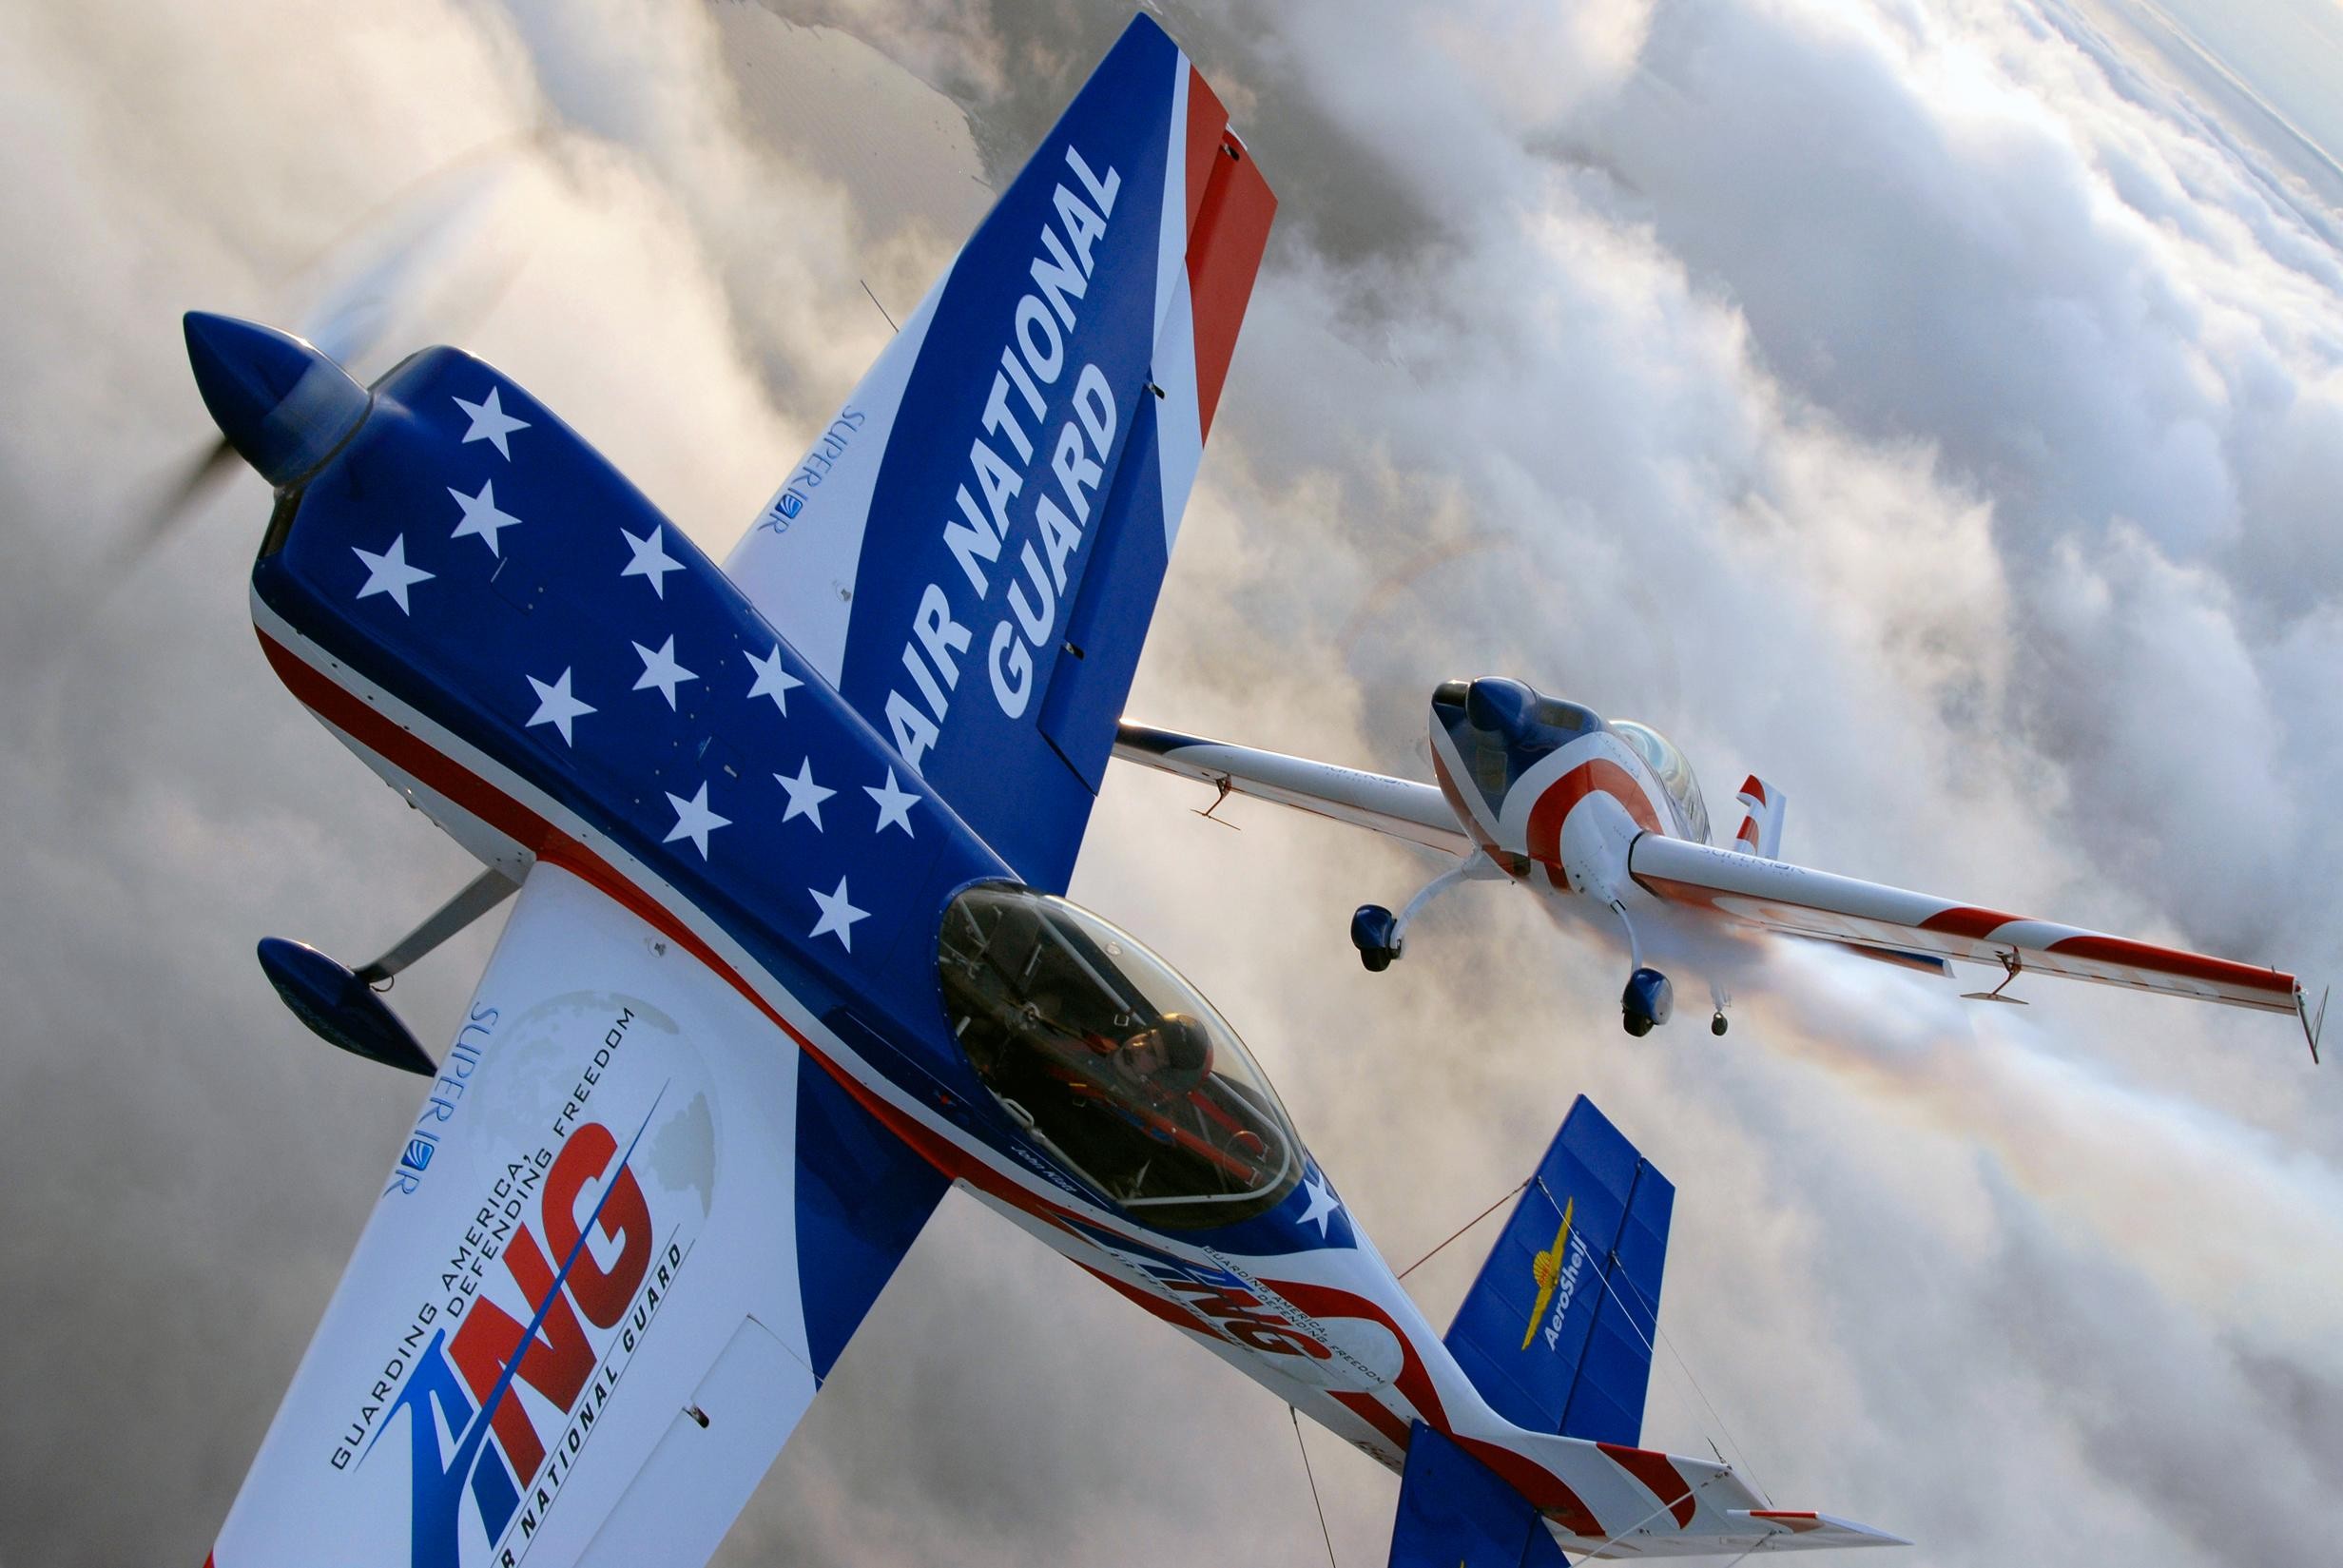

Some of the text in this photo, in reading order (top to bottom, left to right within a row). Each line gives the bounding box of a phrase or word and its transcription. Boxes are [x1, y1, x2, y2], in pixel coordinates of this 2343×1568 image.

[757, 405, 865, 533] SUPERIOR
[884, 144, 1121, 777] AIR NATIONAL
[988, 362, 1117, 720] GUARD
[382, 1001, 498, 1198] SUPERIOR
[446, 1006, 635, 1319] DEFENDING FREEDOM
[331, 1153, 532, 1471] GUARDING AMERICA,
[520, 1243, 681, 1539] NATIONAL GUARD
[1204, 1247, 1269, 1293] GUARDING
[1257, 1295, 1327, 1343] DEFENDING
[1331, 1345, 1385, 1384] FREEDOM
[1544, 1233, 1587, 1351] AeroShell
